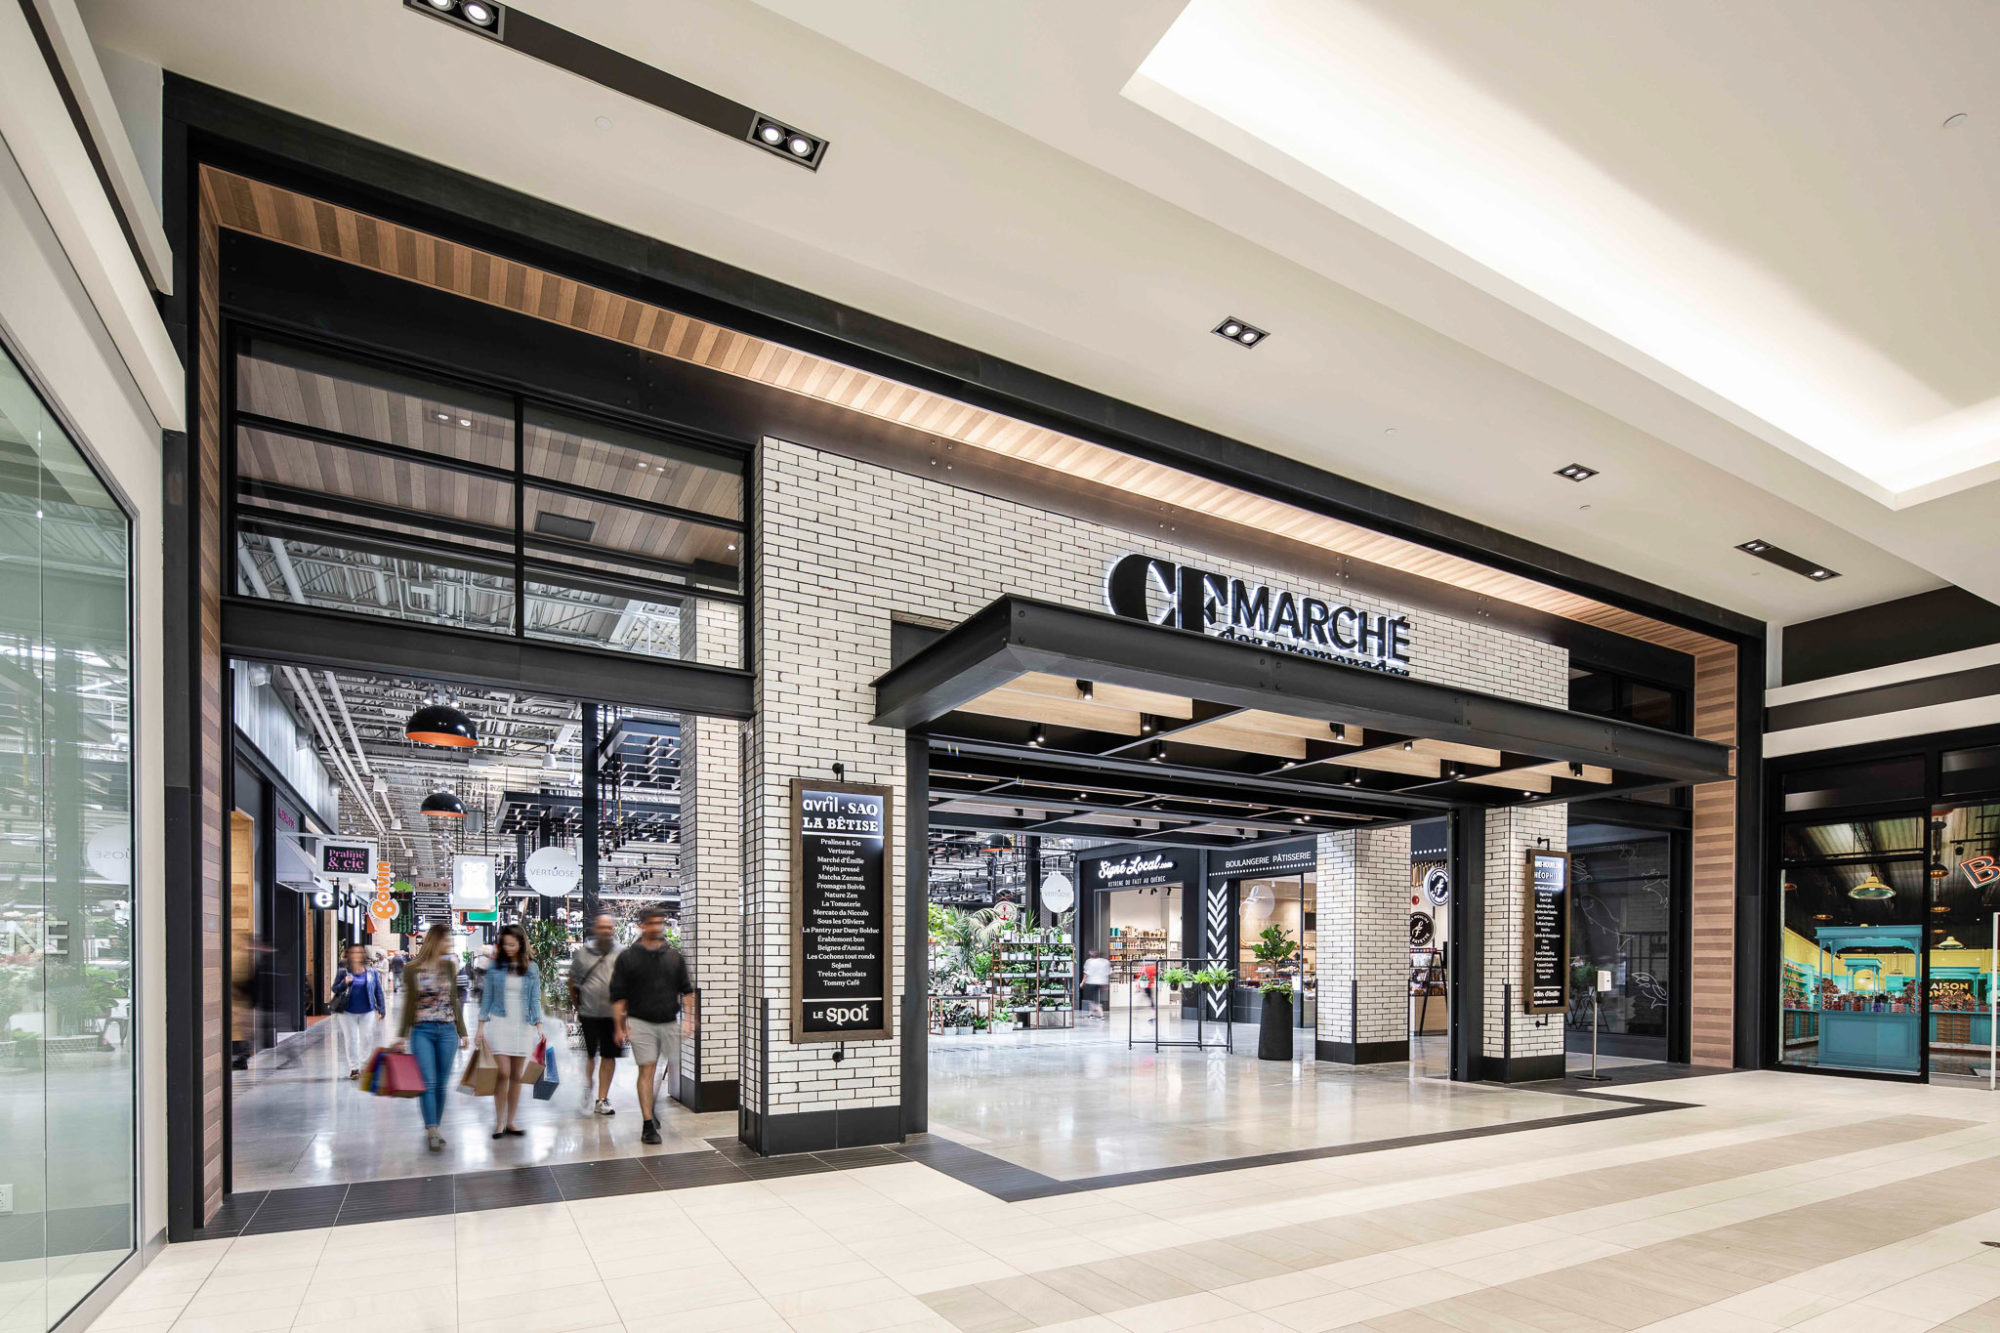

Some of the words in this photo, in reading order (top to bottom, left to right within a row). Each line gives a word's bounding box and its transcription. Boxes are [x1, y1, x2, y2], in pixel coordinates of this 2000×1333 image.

[1230, 577, 1411, 663] MARCHÉ
[803, 797, 838, 812] avril
[848, 803, 878, 816] SAQ
[803, 817, 824, 829] LA
[828, 816, 878, 832] BÊTISE
[328, 856, 338, 868] &
[344, 856, 364, 868] cie
[1225, 856, 1270, 868] BOULANGERIE
[1272, 851, 1312, 863] PÂTISSERIE
[530, 868, 575, 878] VERTUOSE
[822, 865, 840, 873] Pépin
[1098, 859, 1127, 879] Signé
[1930, 982, 1969, 990] AISON
[812, 1011, 824, 1019] LE
[826, 1004, 870, 1026] spot
